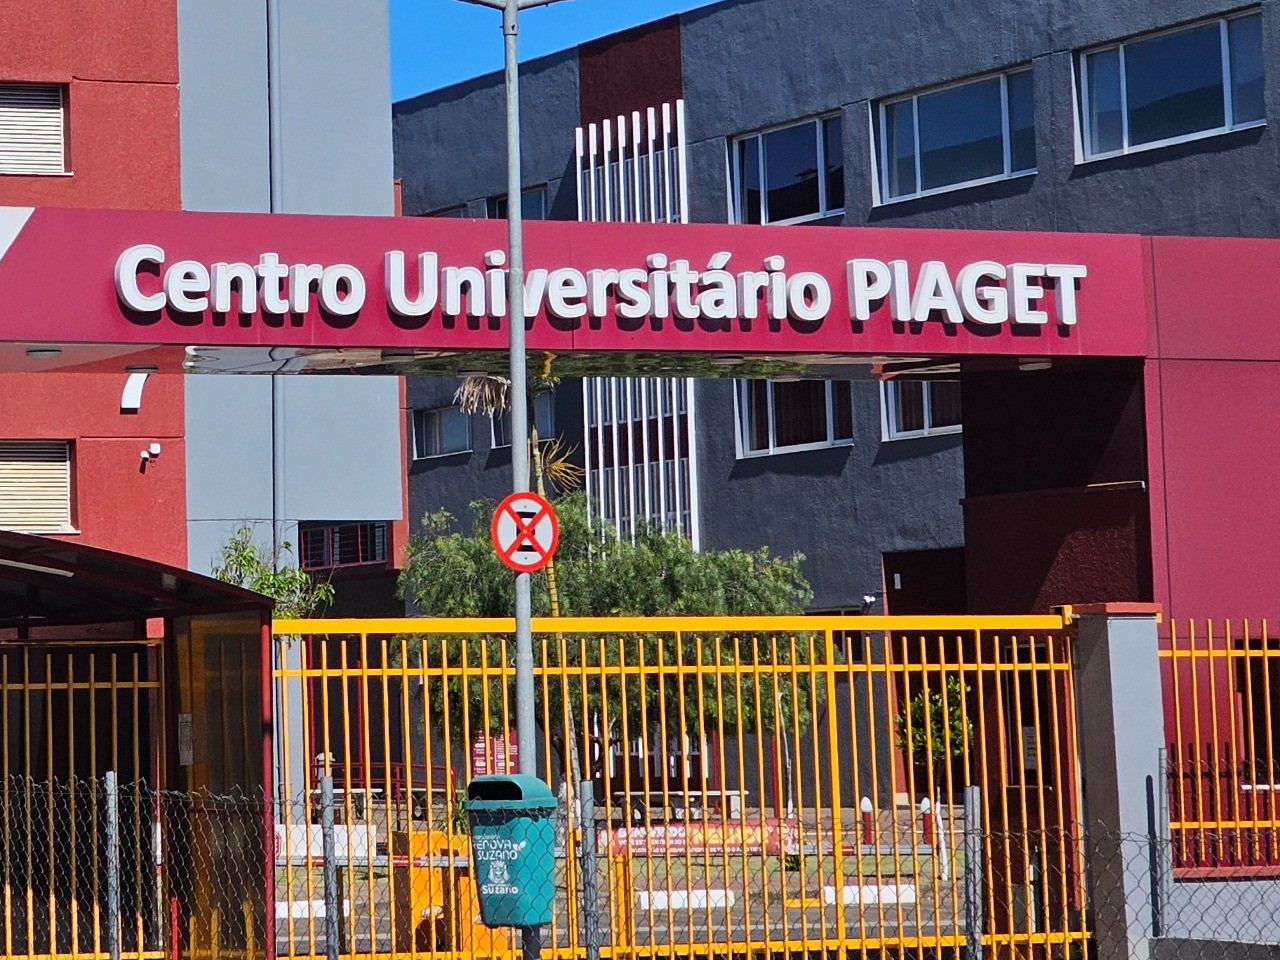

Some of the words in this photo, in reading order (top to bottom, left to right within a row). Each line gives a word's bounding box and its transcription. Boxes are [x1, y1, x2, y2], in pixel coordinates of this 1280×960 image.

[114, 244, 366, 316] Centro
[384, 250, 832, 321] Universitário
[846, 258, 1088, 324] PIAGET
[477, 850, 518, 861] SUZANO
[482, 884, 519, 895] Suzano
